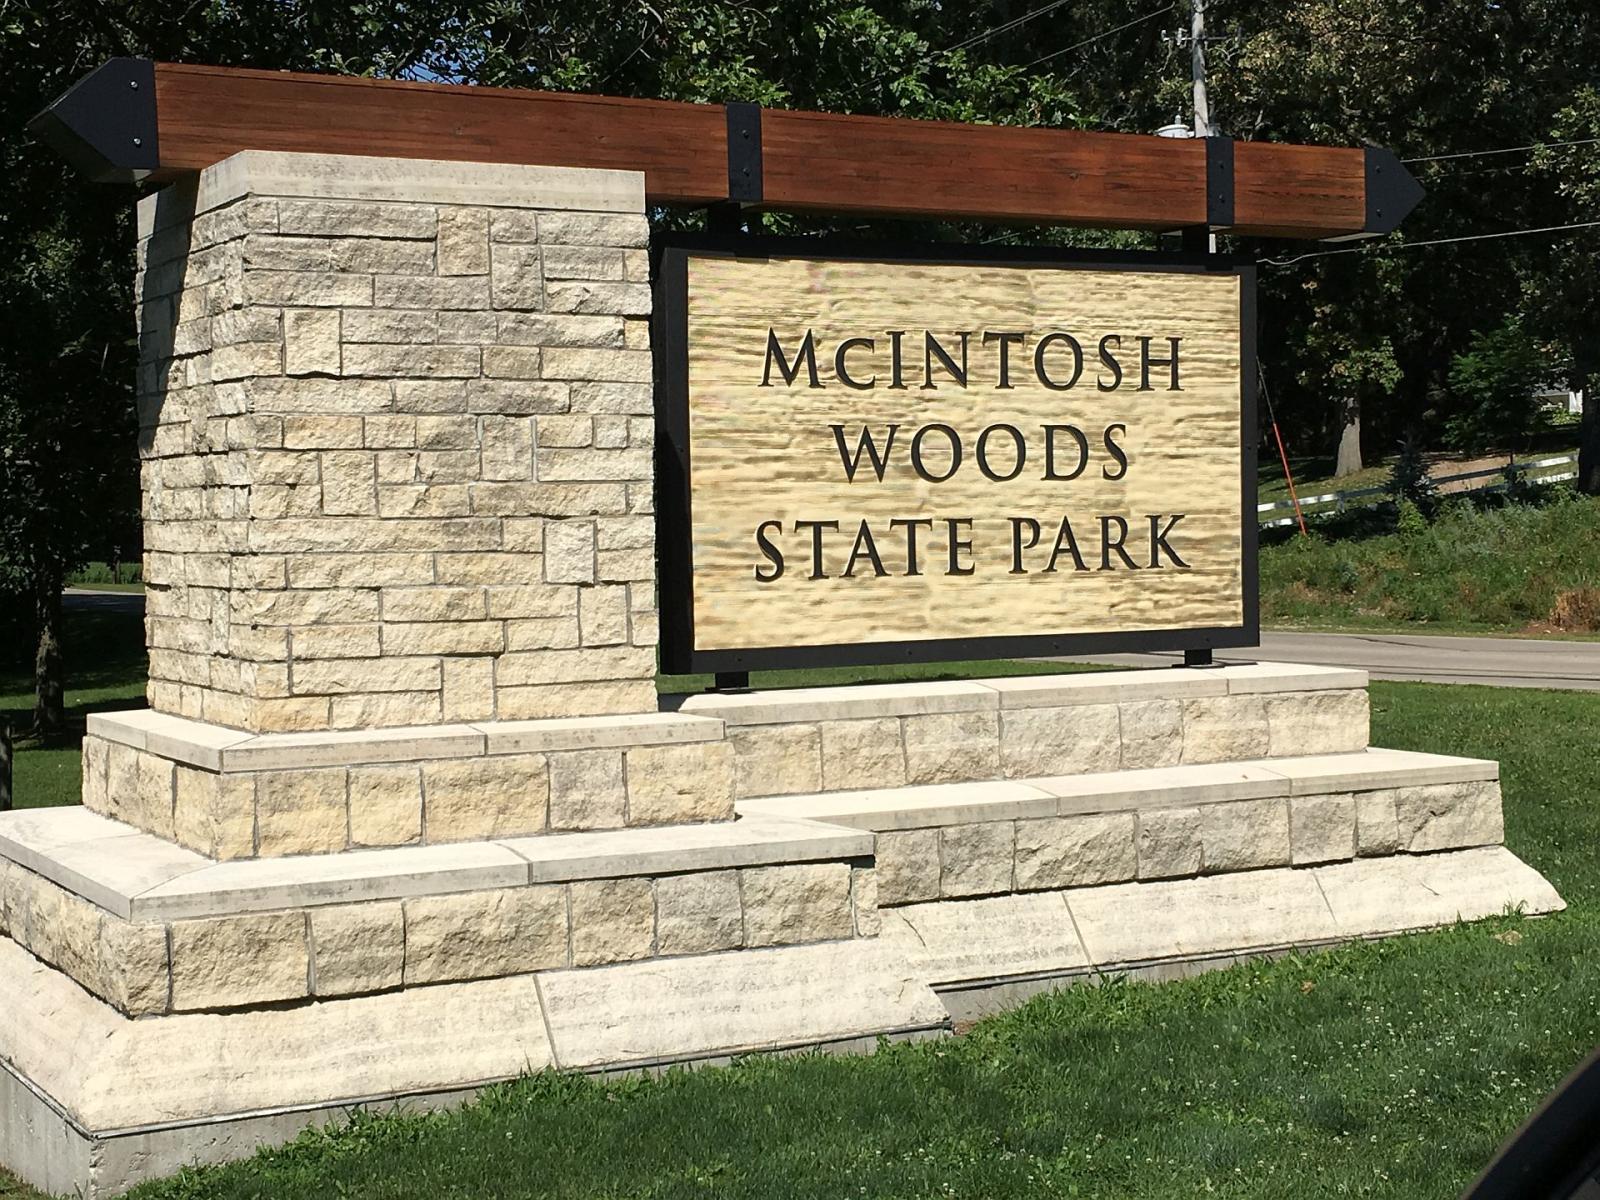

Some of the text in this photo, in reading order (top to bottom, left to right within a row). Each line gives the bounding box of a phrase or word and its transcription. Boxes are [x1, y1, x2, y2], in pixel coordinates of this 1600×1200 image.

[828, 423, 1129, 483] WOODS
[755, 514, 1191, 582] STATE PARK
